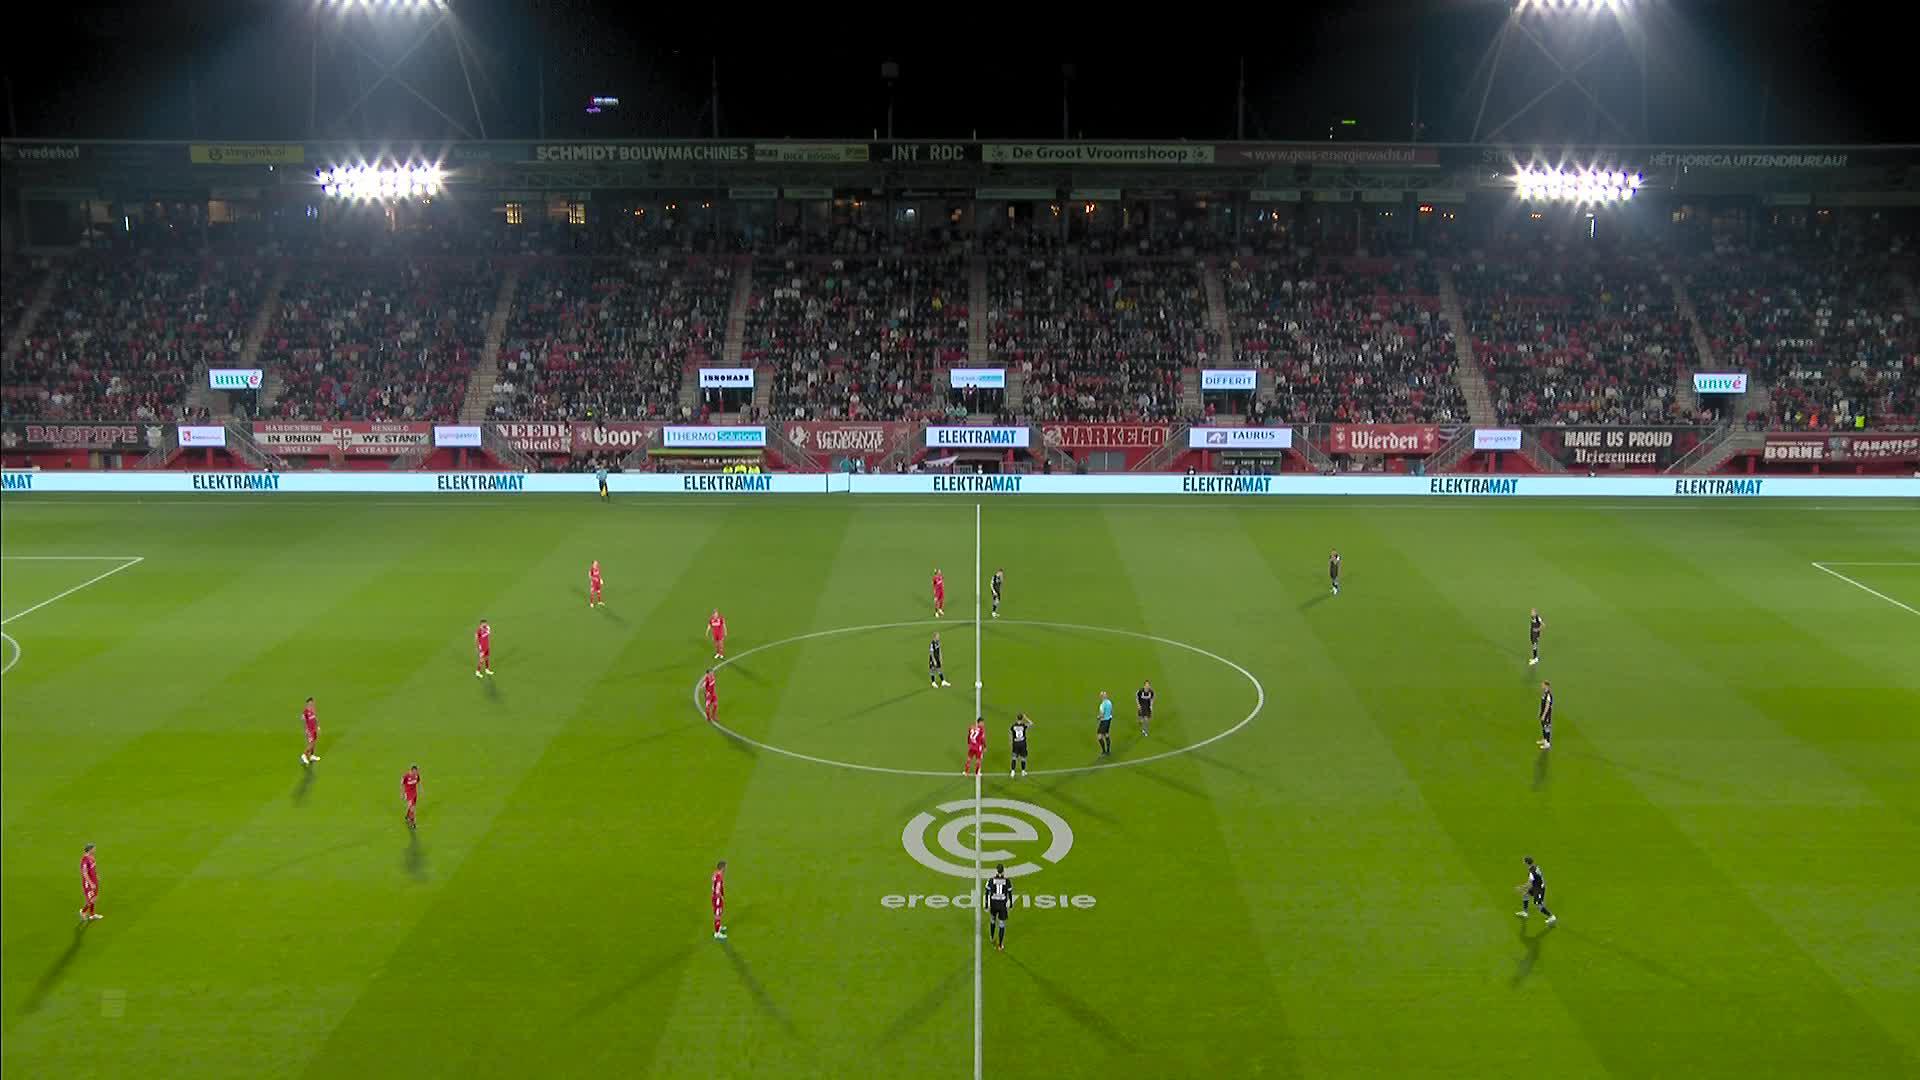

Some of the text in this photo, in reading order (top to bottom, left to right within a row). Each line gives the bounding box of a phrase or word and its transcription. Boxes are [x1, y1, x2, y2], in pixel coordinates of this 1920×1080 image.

[19, 146, 80, 160] vredehof
[537, 146, 616, 160] SCHMIDT
[620, 146, 748, 160] BOUWMACHINES
[1012, 146, 1188, 164] De Groot Vroomshoop
[1677, 154, 1732, 167] HORECA
[1205, 376, 1252, 385] DIFFERIT
[26, 425, 138, 443] BAGPIPE
[267, 434, 321, 443] IN UNION
[361, 434, 424, 443] WE STAND
[496, 424, 572, 438] NEEDE
[594, 426, 643, 446] Goor
[672, 431, 761, 441] THERMO Solutions
[938, 430, 1016, 444] ELEKTRAMAT
[1059, 426, 1166, 447] MARKELO
[1232, 431, 1275, 439] TAURUS
[1351, 430, 1418, 449] Wierden
[1564, 432, 1673, 447] MAKE US PROUD
[1764, 446, 1823, 459] BORNE
[193, 474, 280, 489] ELEKTRAMAT
[438, 474, 524, 490] ELEKTRAMAT
[684, 475, 772, 490] ELEKTRAMAT
[933, 476, 1021, 491] ELEKTRAMAT
[1183, 477, 1271, 492] ELEKTRAMAT
[1431, 478, 1518, 493] ELEKTRAMAT
[1675, 479, 1763, 494] ELEKTRAMAT
[996, 884, 1003, 895] 11
[880, 888, 1097, 909] eredisie
